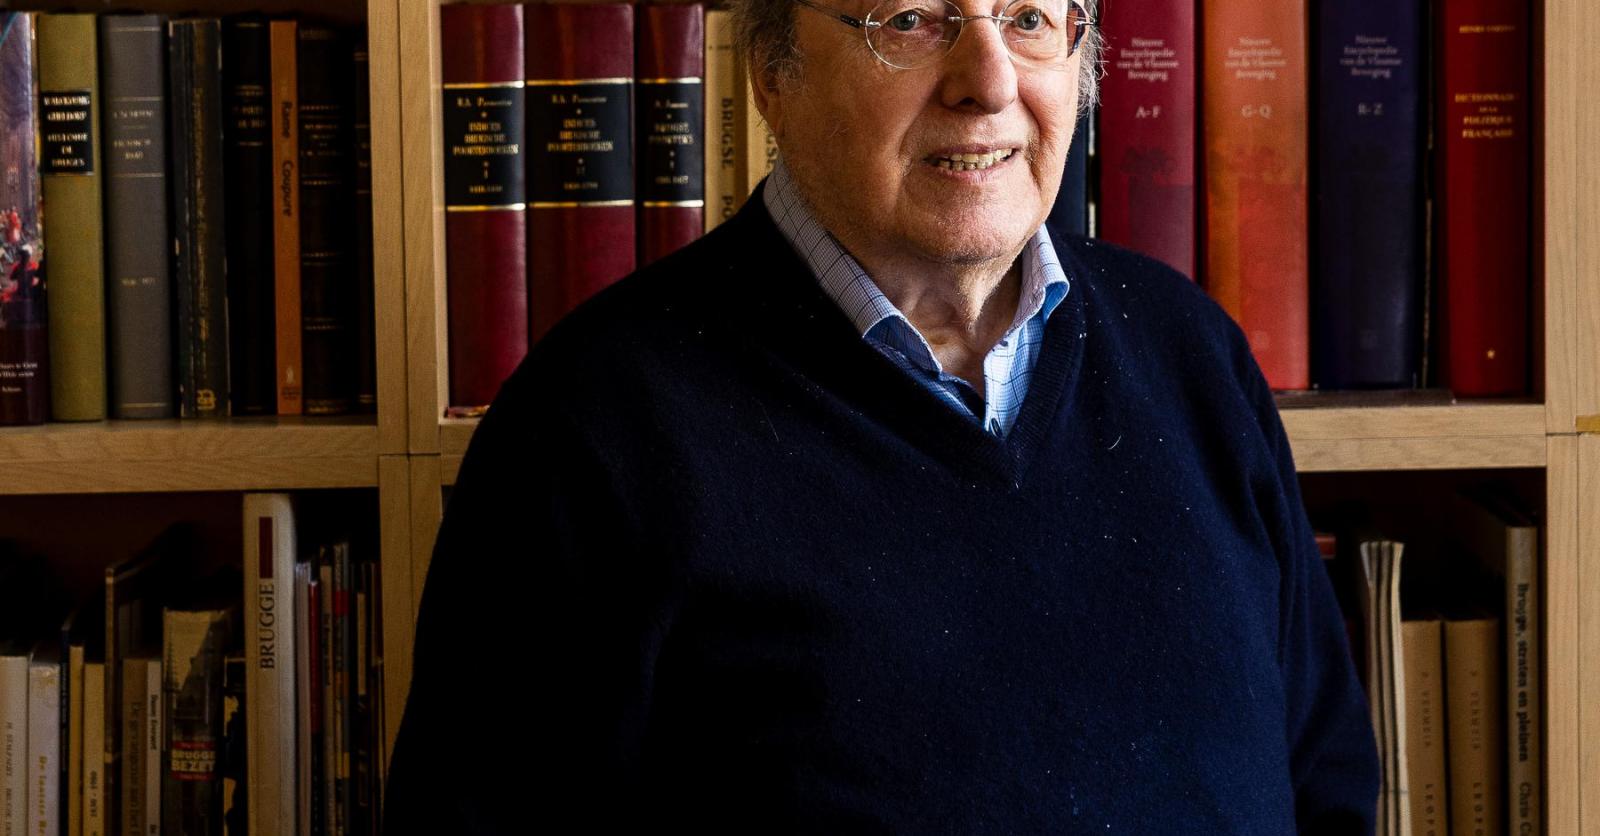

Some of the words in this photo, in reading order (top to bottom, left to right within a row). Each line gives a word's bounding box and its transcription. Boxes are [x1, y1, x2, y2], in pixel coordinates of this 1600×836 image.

[722, 98, 734, 168] BRUGSE
[258, 583, 275, 669] BRUGGE
[1517, 641, 1529, 687] straten
[1518, 690, 1528, 707] en
[172, 750, 216, 760] BRUGGE
[1516, 711, 1531, 762] pleinen
[171, 760, 216, 772] BEZET
